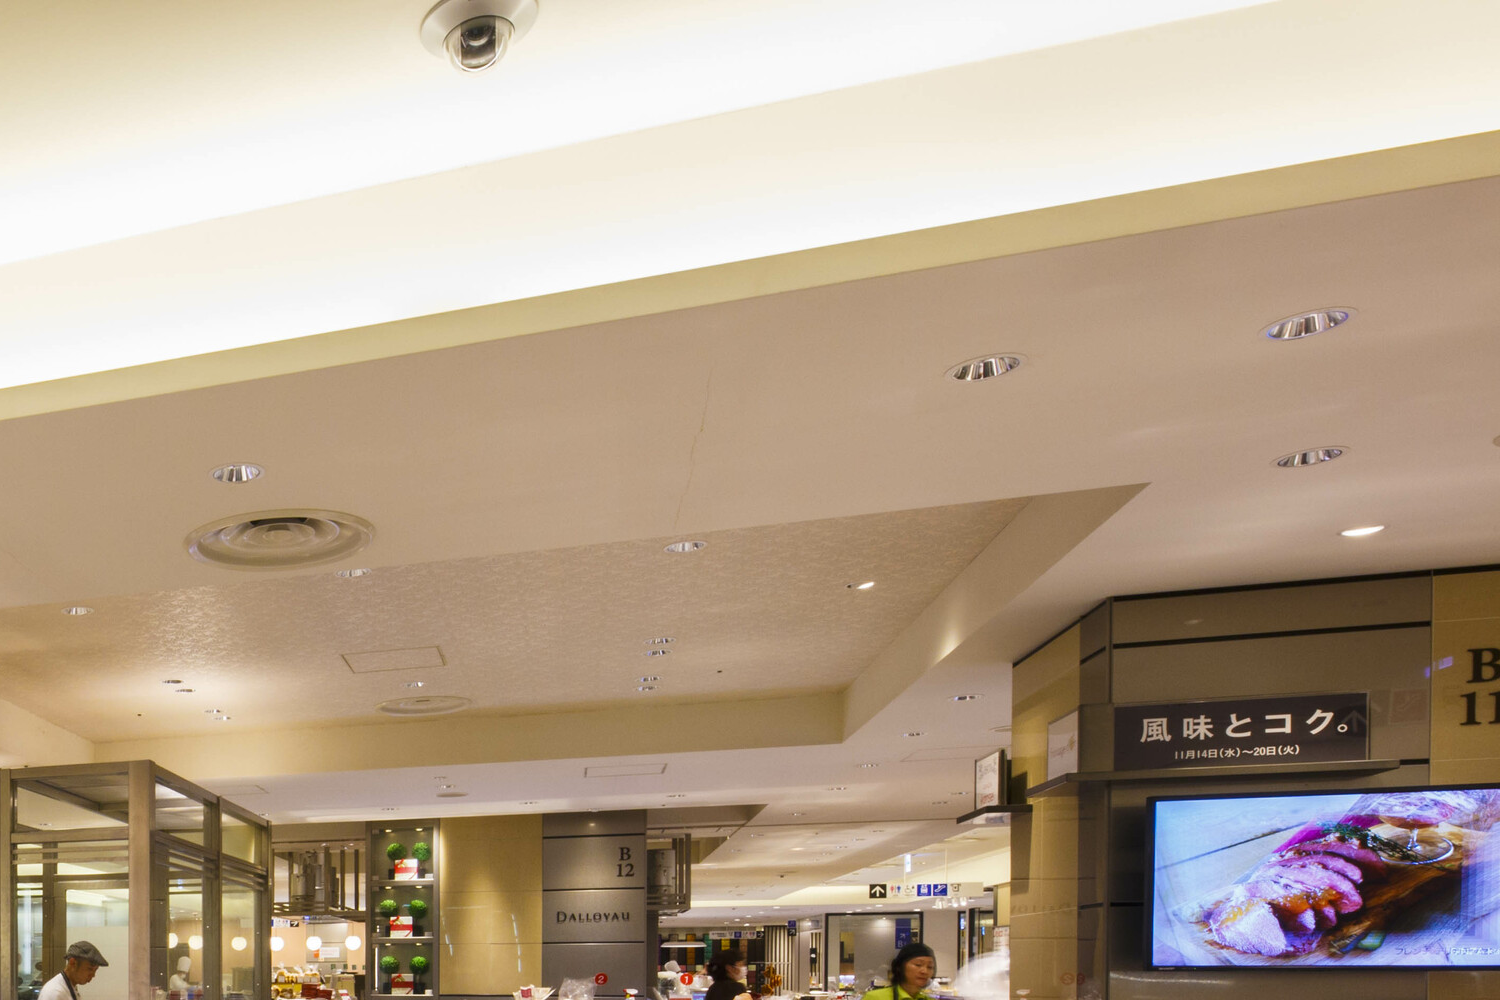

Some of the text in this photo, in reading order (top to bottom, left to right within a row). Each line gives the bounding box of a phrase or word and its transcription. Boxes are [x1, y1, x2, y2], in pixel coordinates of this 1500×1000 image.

[1466, 647, 1500, 684] B
[1139, 708, 1349, 743] 風味とコク。
[618, 846, 632, 861] B
[616, 863, 635, 877] 12
[556, 910, 630, 924] DALLOYAU
[597, 975, 605, 984] 2
